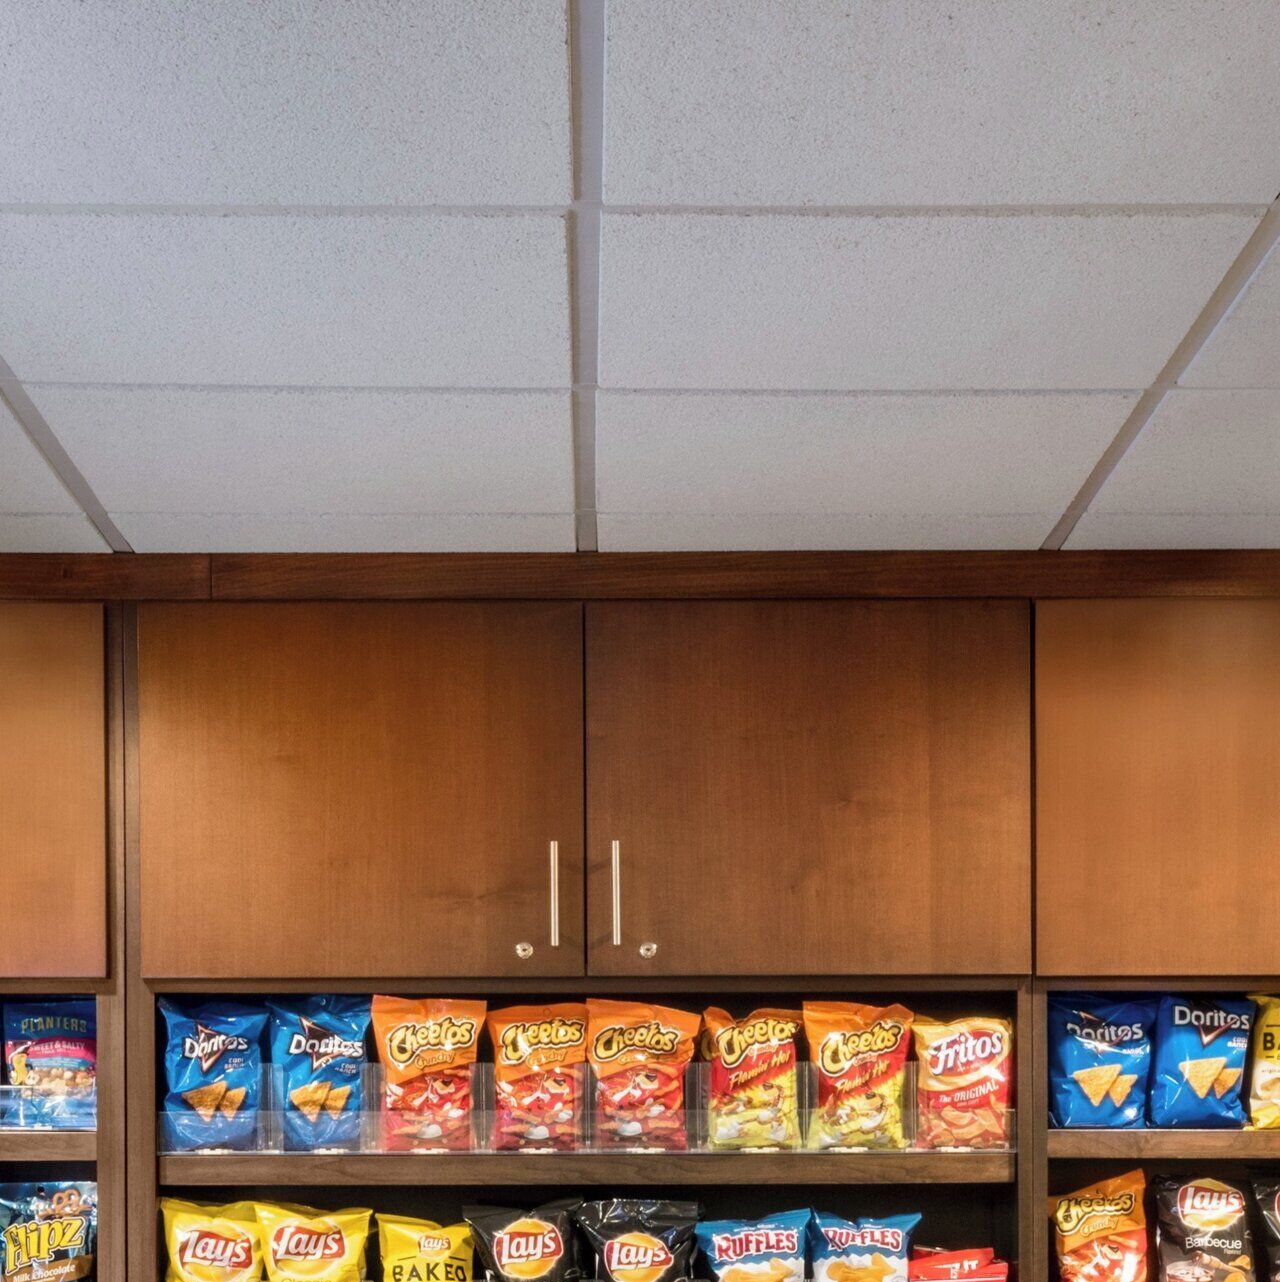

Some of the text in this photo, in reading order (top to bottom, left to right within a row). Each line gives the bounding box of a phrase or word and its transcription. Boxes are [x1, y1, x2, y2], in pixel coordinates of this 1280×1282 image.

[22, 1015, 87, 1034] PLANTERS
[1174, 1006, 1250, 1030] Doritos
[289, 1033, 363, 1060] Doritos
[385, 1017, 478, 1064] Cheetos
[500, 1018, 586, 1063] Cheetos
[593, 1021, 681, 1057] Cheetos
[717, 1018, 799, 1069] Cheetos
[819, 1020, 901, 1076] Cheetos
[928, 1030, 1006, 1077] Fritos
[1056, 1191, 1135, 1231] Cheetos
[3, 1217, 85, 1275] Flipz
[183, 1230, 252, 1268] Lay's
[275, 1226, 345, 1260] Lay's
[419, 1235, 450, 1253] Lay's
[500, 1230, 561, 1265] Lay's
[610, 1241, 668, 1271] Lay's
[715, 1229, 799, 1261] RUFFLES
[825, 1227, 902, 1252] RUFFLES
[1185, 1237, 1242, 1250] Barbecue
[392, 1262, 468, 1282] BAKED
